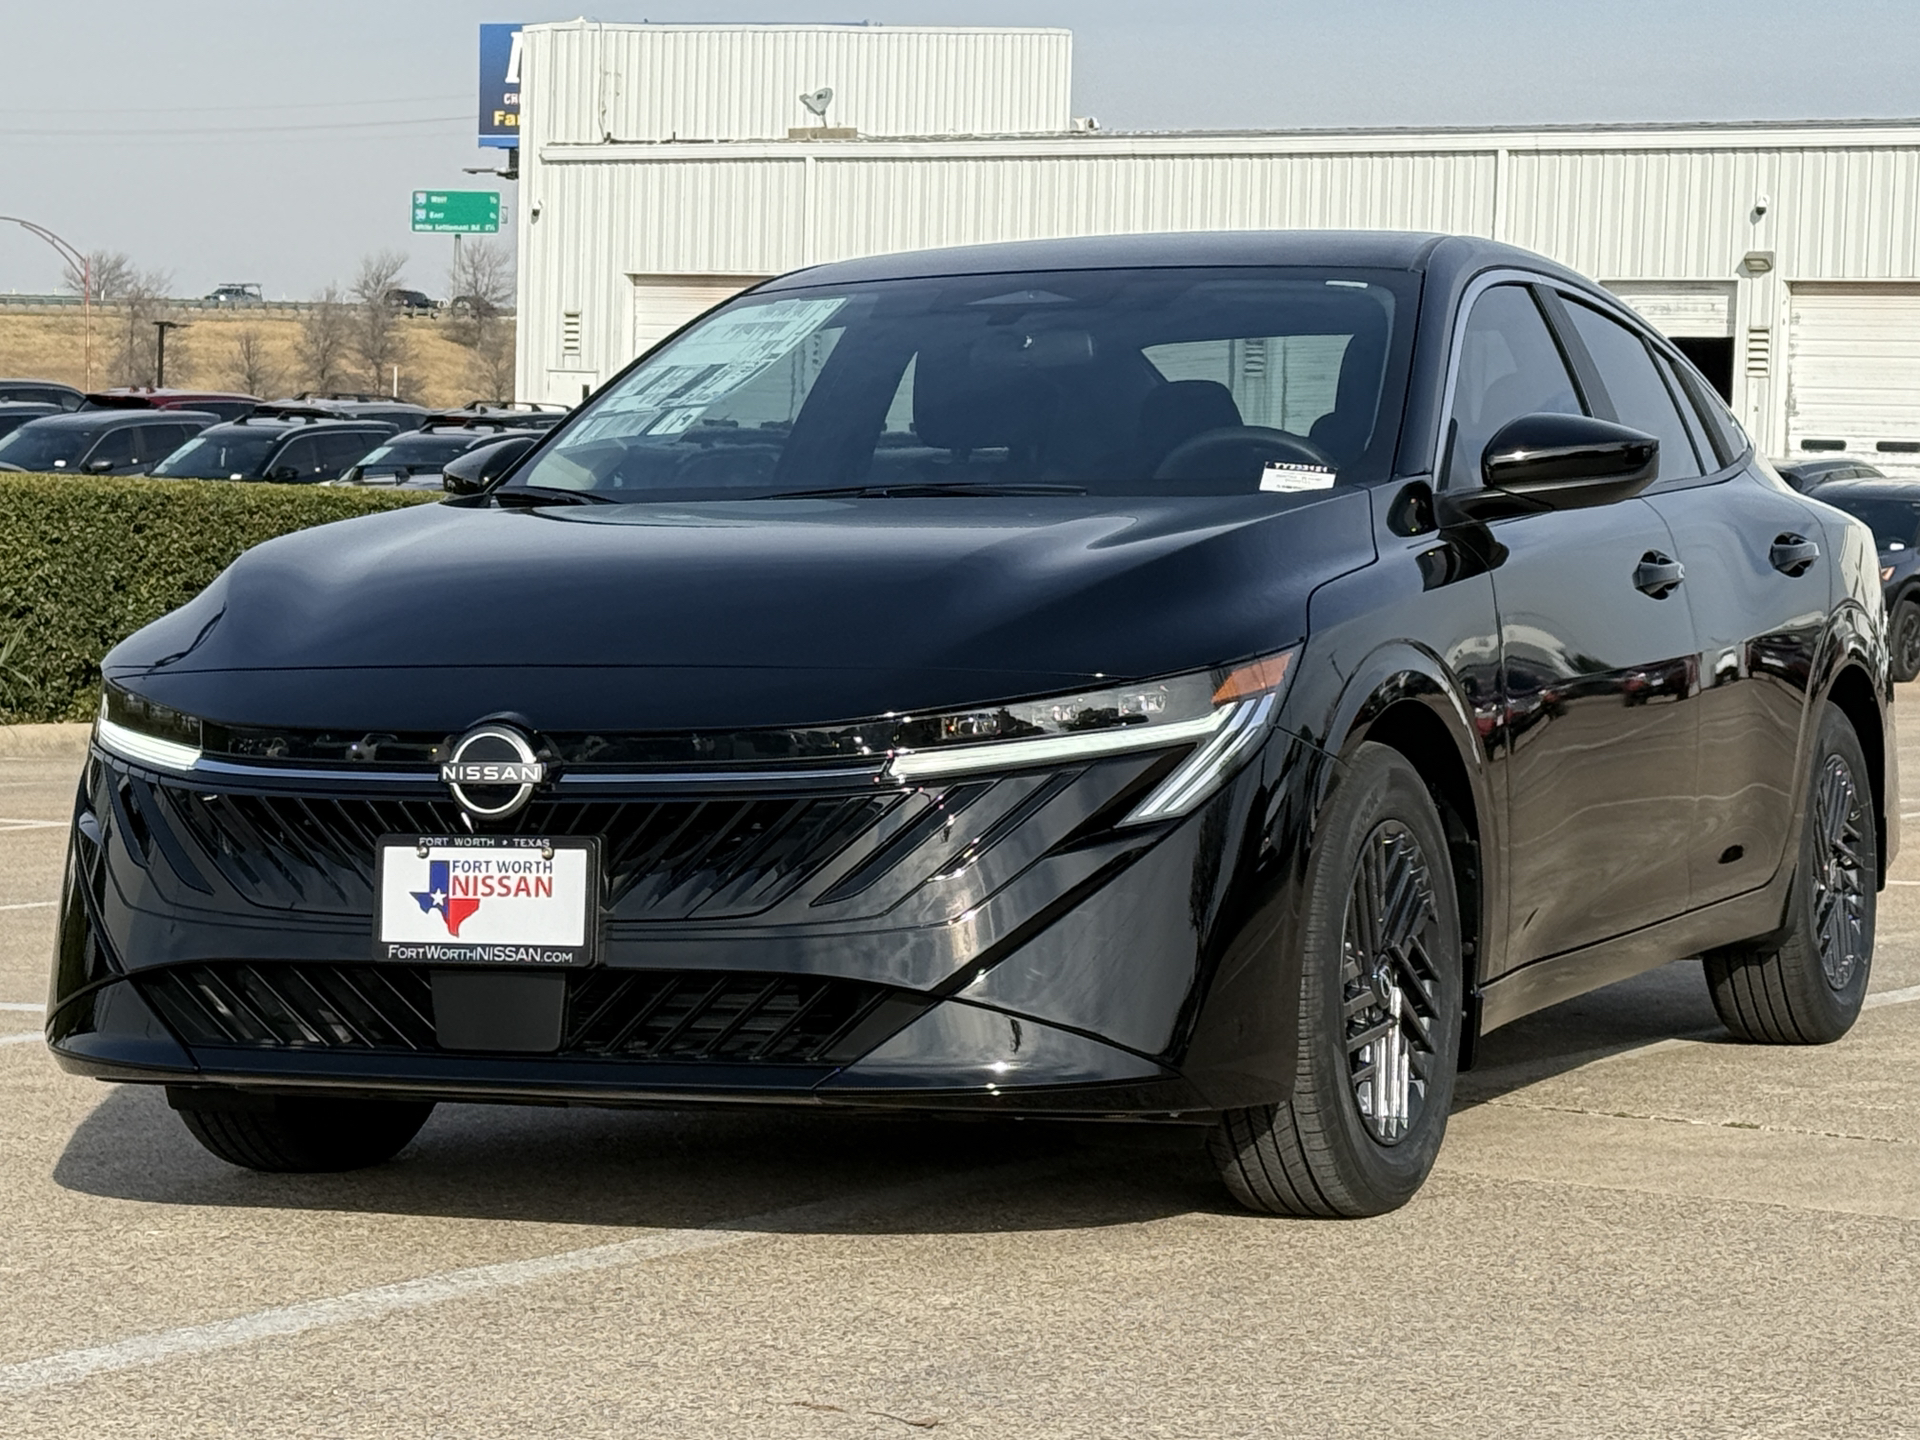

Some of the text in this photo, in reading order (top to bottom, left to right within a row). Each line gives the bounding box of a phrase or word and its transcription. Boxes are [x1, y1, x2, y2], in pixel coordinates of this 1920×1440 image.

[442, 766, 539, 781] NISSAN
[419, 837, 550, 847] FORT WORTH TEXAS
[452, 860, 553, 874] FORT WORTH
[452, 875, 553, 898] NISSAN
